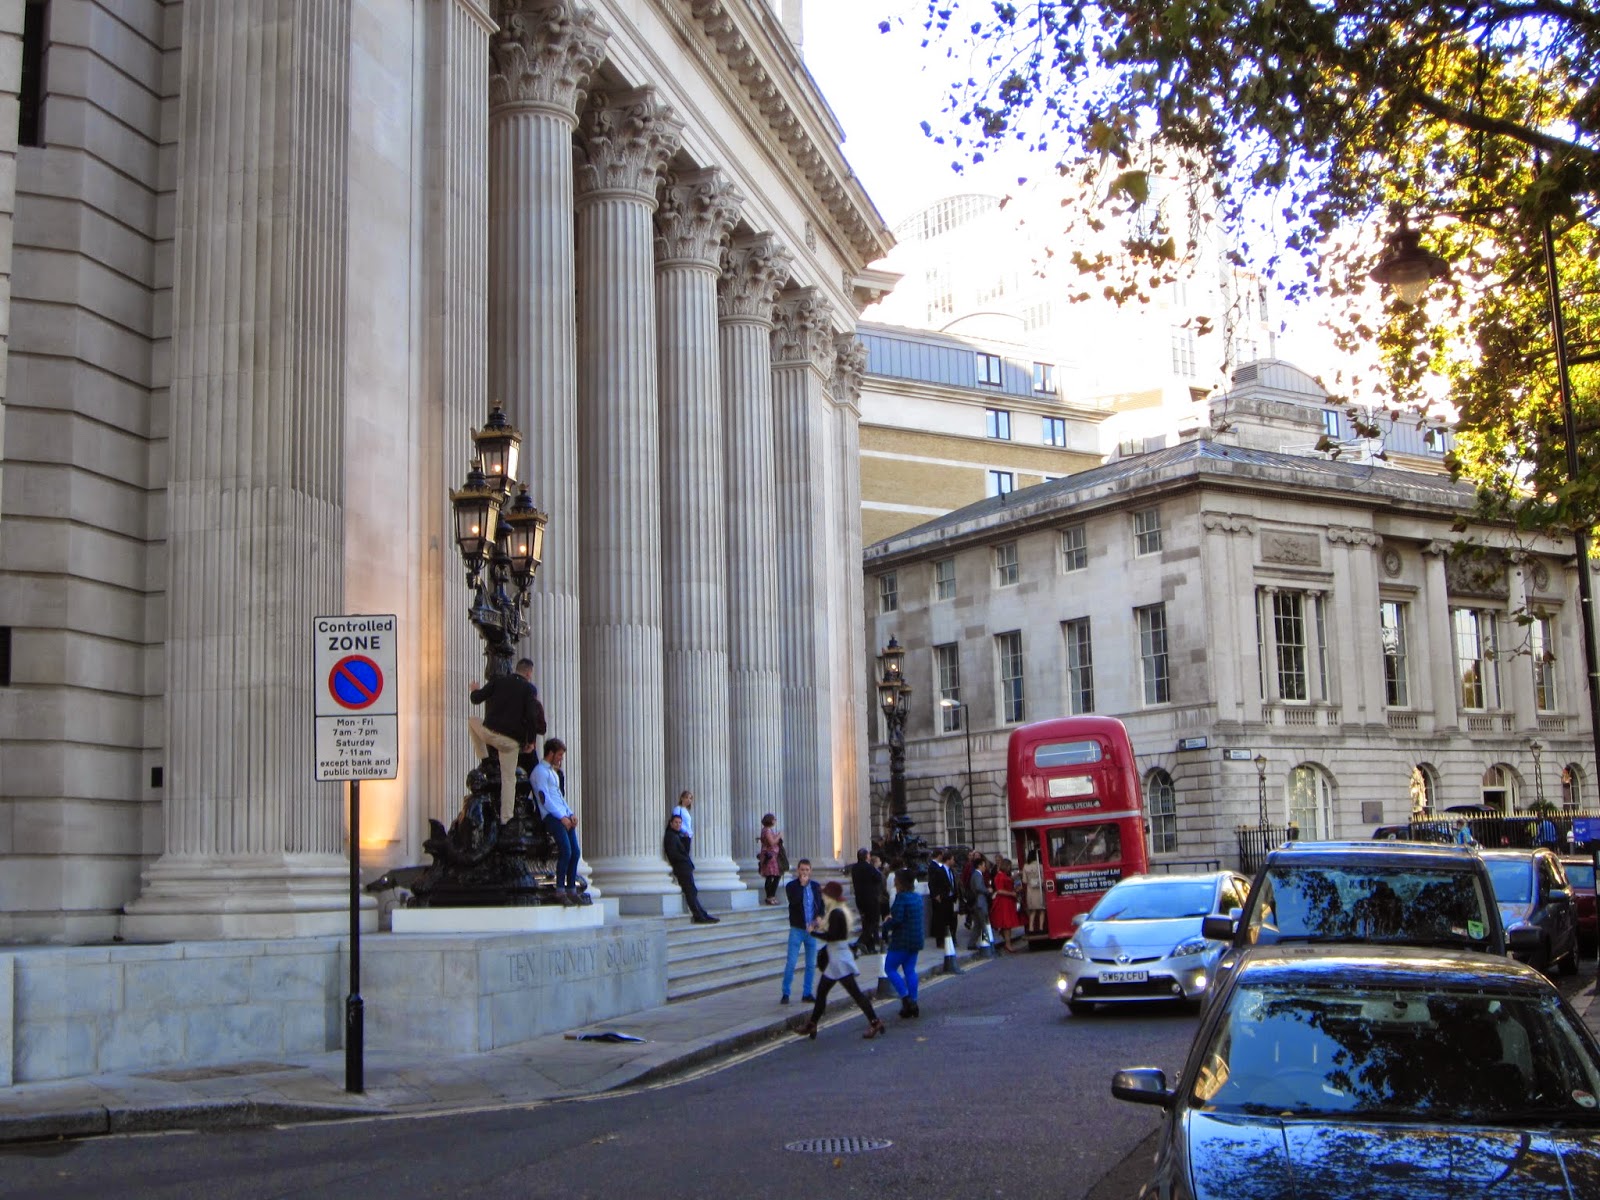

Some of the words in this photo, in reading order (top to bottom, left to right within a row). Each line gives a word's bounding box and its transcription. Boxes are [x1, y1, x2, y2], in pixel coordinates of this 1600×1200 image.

[319, 620, 392, 633] Controlled
[328, 636, 380, 650] ZONE
[336, 739, 375, 747] Saturday
[320, 759, 349, 767] except
[351, 758, 372, 766] bank
[375, 758, 391, 766] and
[323, 768, 350, 777] public
[352, 767, 388, 776] holidays
[506, 952, 536, 982] TEN
[547, 945, 598, 976] TRINITY
[606, 938, 649, 971] SQUARE
[1126, 971, 1144, 980] CFU
